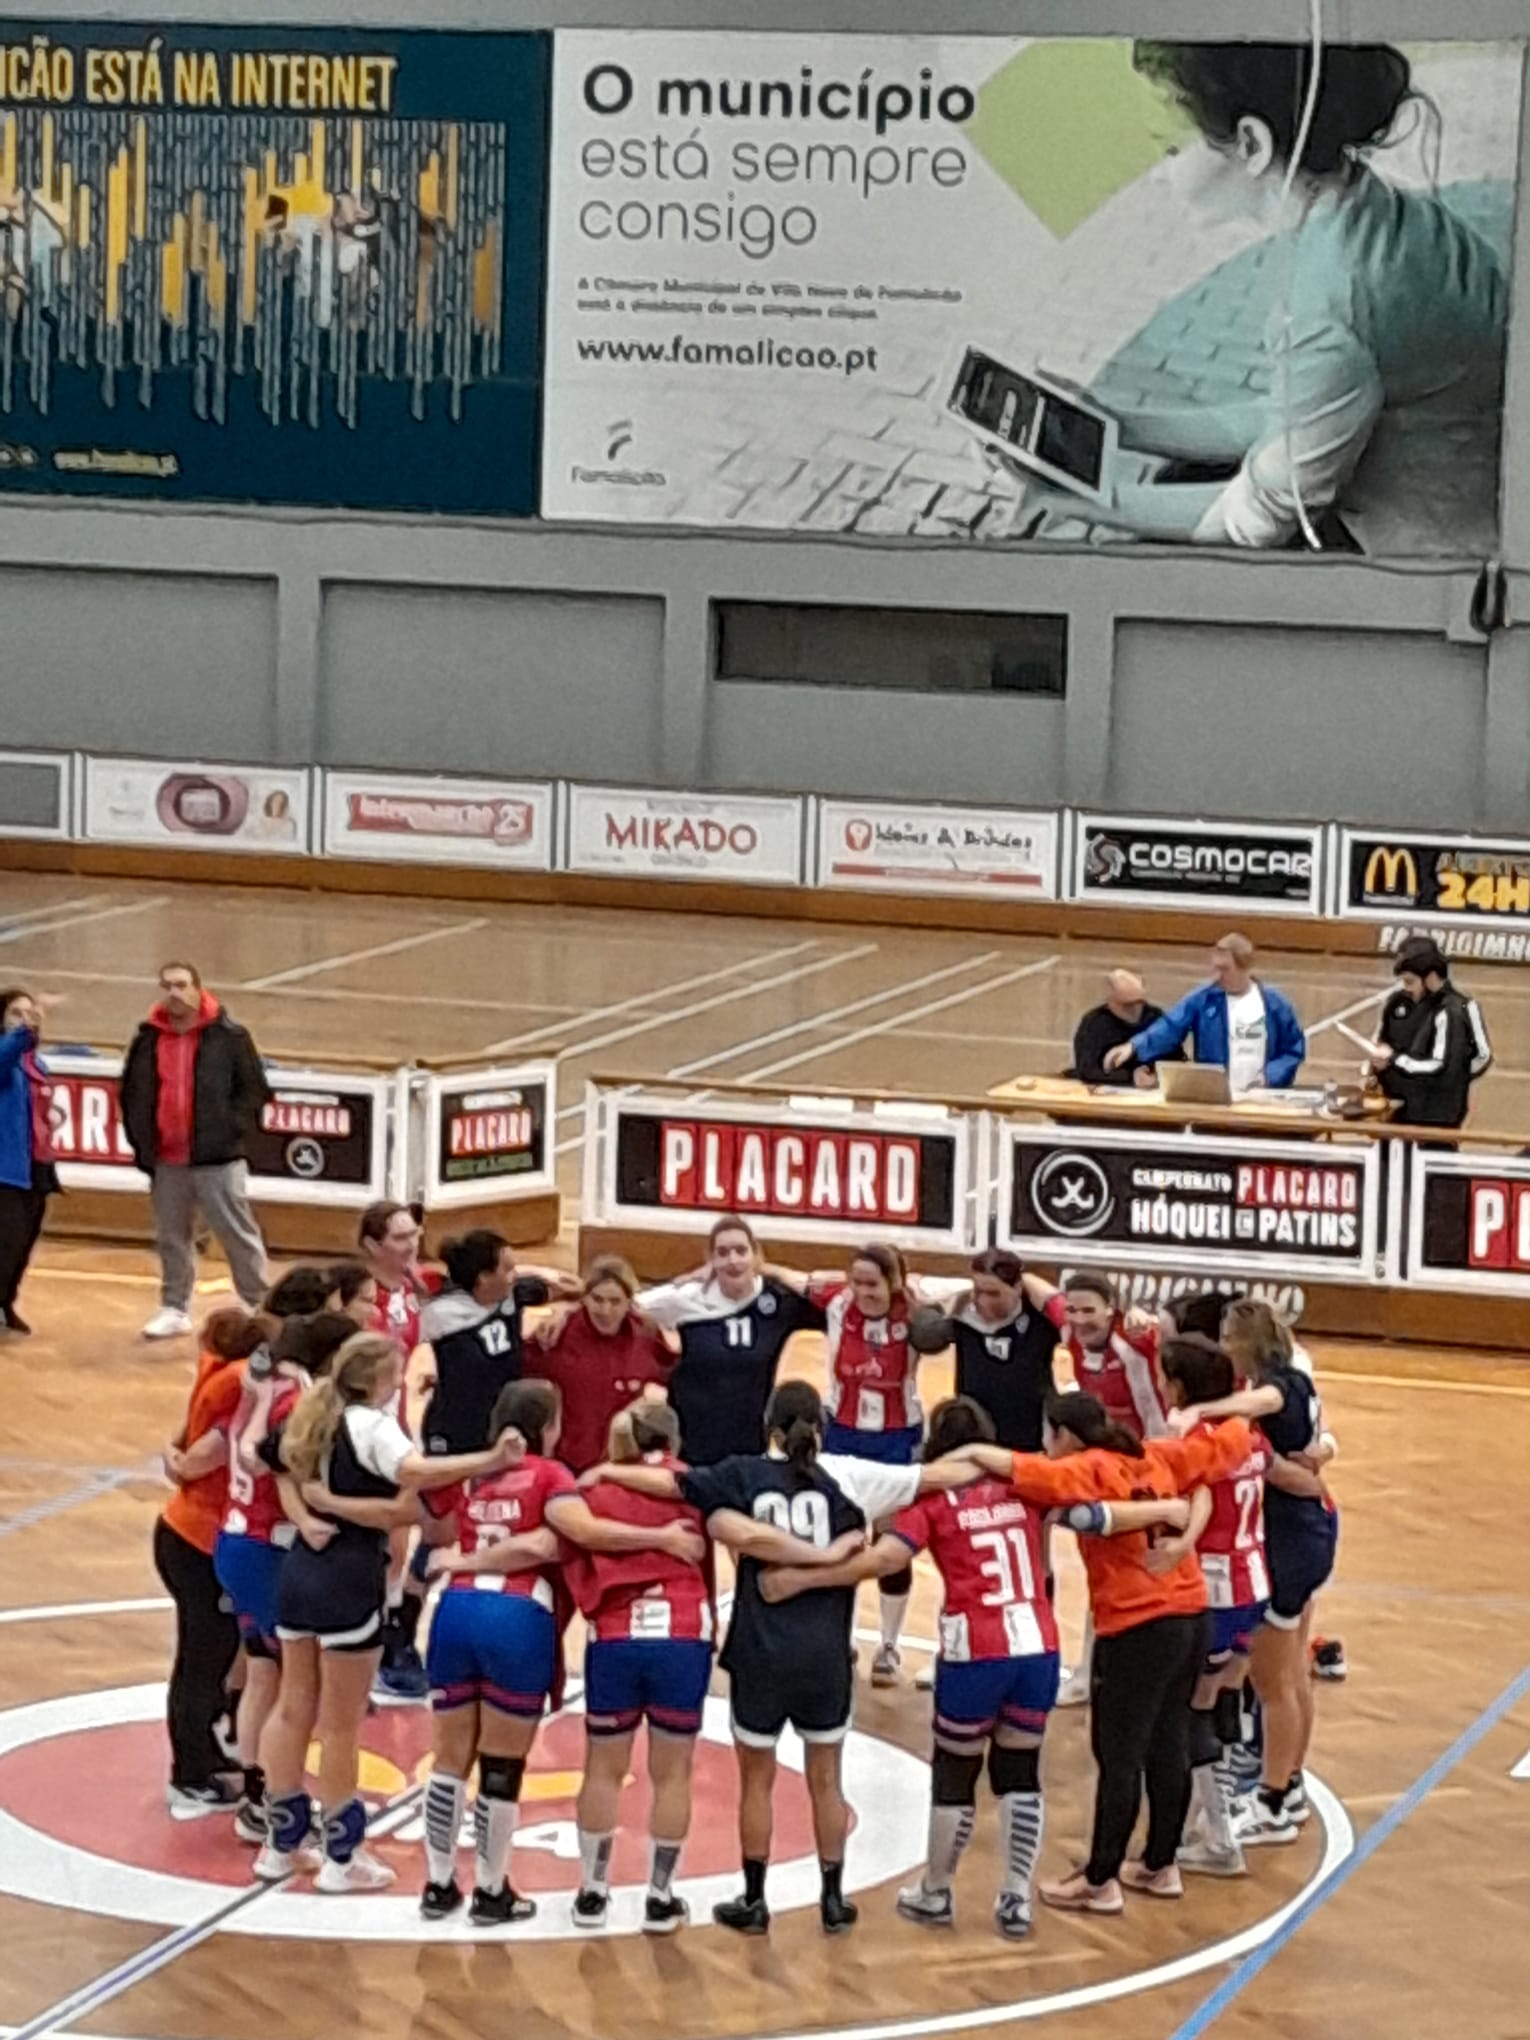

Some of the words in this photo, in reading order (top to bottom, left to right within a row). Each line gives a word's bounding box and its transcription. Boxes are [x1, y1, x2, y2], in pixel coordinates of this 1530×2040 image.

[86, 36, 164, 105] ESTÁ
[173, 50, 221, 108] NA
[232, 52, 398, 112] INTERNET
[583, 63, 634, 115] O
[657, 66, 976, 135] município
[581, 127, 709, 180] está
[731, 141, 968, 199] sempre
[579, 190, 818, 260] consigo
[577, 334, 878, 375] www.famalicao.pt
[605, 812, 758, 855] MIKADO
[1128, 842, 1312, 877] COSMOCAR
[663, 1127, 917, 1214] PLACARD
[1237, 1164, 1357, 1208] PLACARD
[1130, 1192, 1231, 1240] HÓQUEI
[1258, 1207, 1357, 1248] PATINS
[725, 1315, 752, 1347] 11
[969, 1527, 1035, 1607] 31
